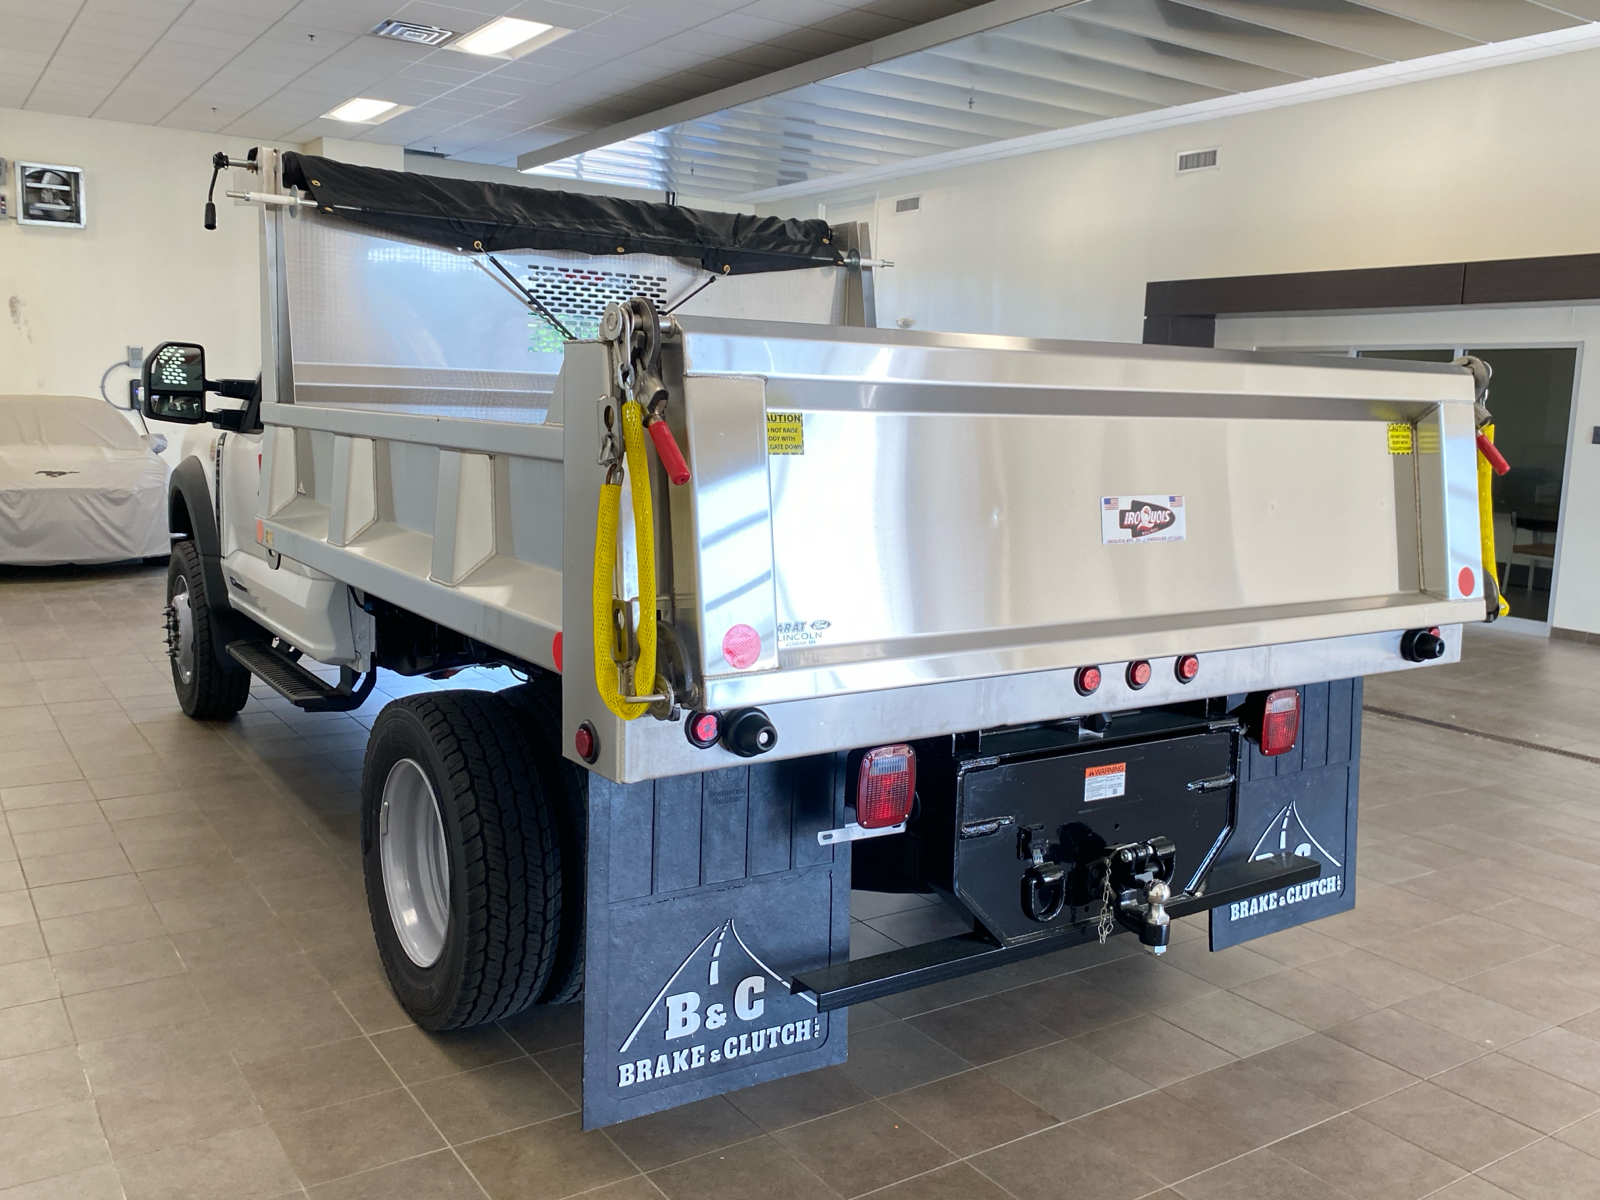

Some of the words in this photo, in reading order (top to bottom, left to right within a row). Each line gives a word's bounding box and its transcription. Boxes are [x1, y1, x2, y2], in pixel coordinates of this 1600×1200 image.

[766, 414, 800, 422] AUTION
[1124, 506, 1171, 528] IROQUOIS
[777, 620, 807, 633] ARAT
[777, 632, 822, 642] LINCOLN
[1095, 764, 1124, 776] WARNING
[1230, 892, 1277, 921] BRAKE
[1279, 896, 1286, 907] &
[1286, 875, 1336, 905] CLUTCH
[664, 991, 701, 1041] B
[705, 1003, 727, 1030] &
[734, 975, 765, 1021] C
[617, 1044, 706, 1088] BRAKE
[709, 1049, 721, 1063] &
[723, 1019, 811, 1060] CLUTCH
